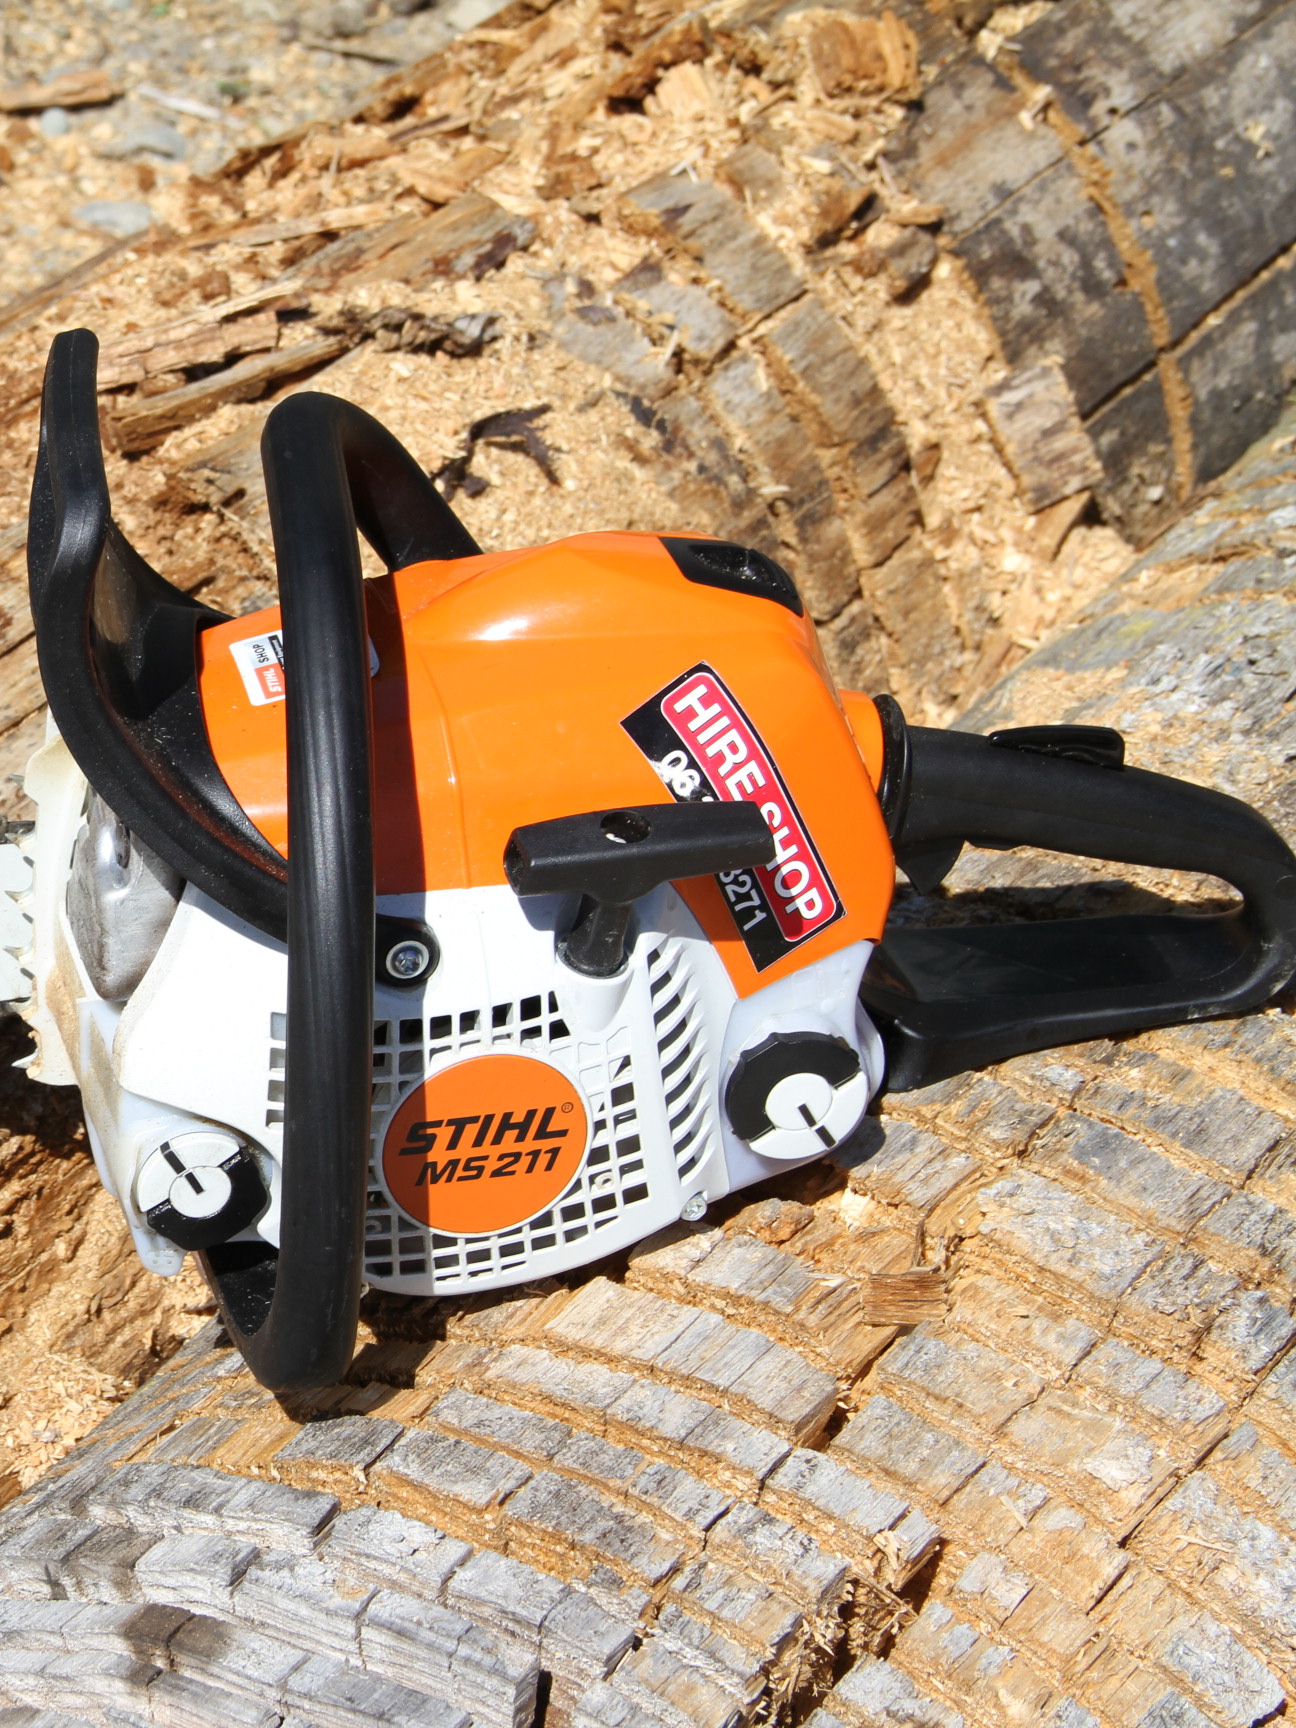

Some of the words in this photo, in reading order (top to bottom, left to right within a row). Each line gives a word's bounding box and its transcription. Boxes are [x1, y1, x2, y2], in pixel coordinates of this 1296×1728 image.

[253, 643, 269, 663] SHOP
[263, 668, 282, 692] STIHL
[673, 683, 765, 801] HIRE
[398, 1106, 569, 1156] STIHL
